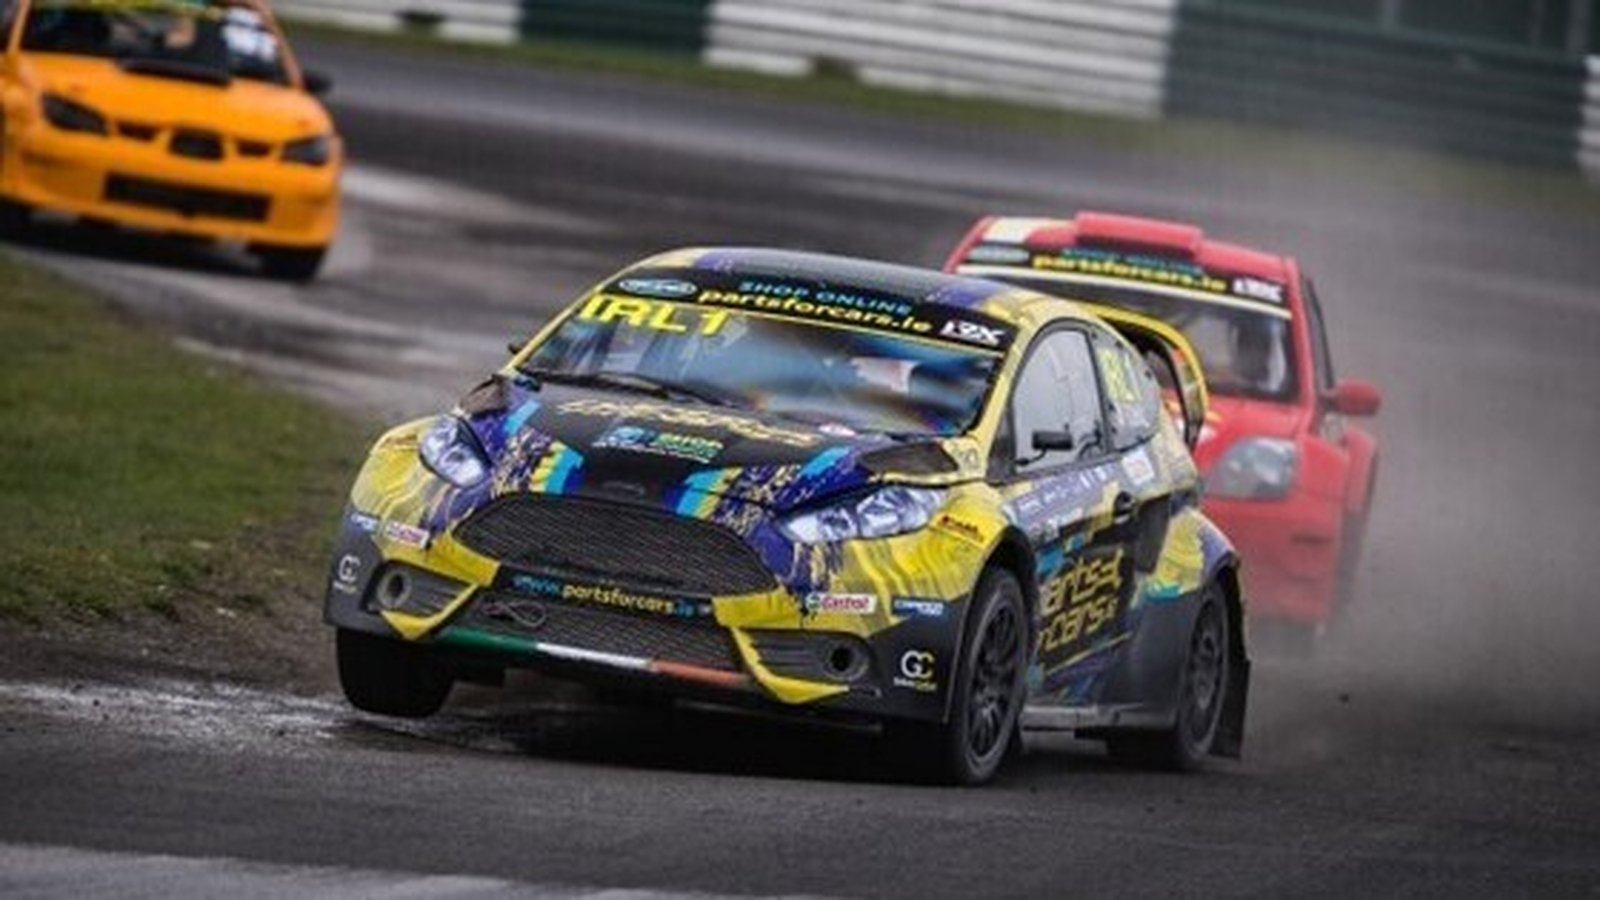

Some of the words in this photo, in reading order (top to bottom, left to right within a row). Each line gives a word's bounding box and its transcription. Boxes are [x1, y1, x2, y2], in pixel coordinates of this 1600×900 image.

[698, 290, 933, 333] partsforcars.ie
[740, 281, 809, 299] SHOP
[816, 292, 913, 315] ONLINE
[901, 650, 935, 679] GC
